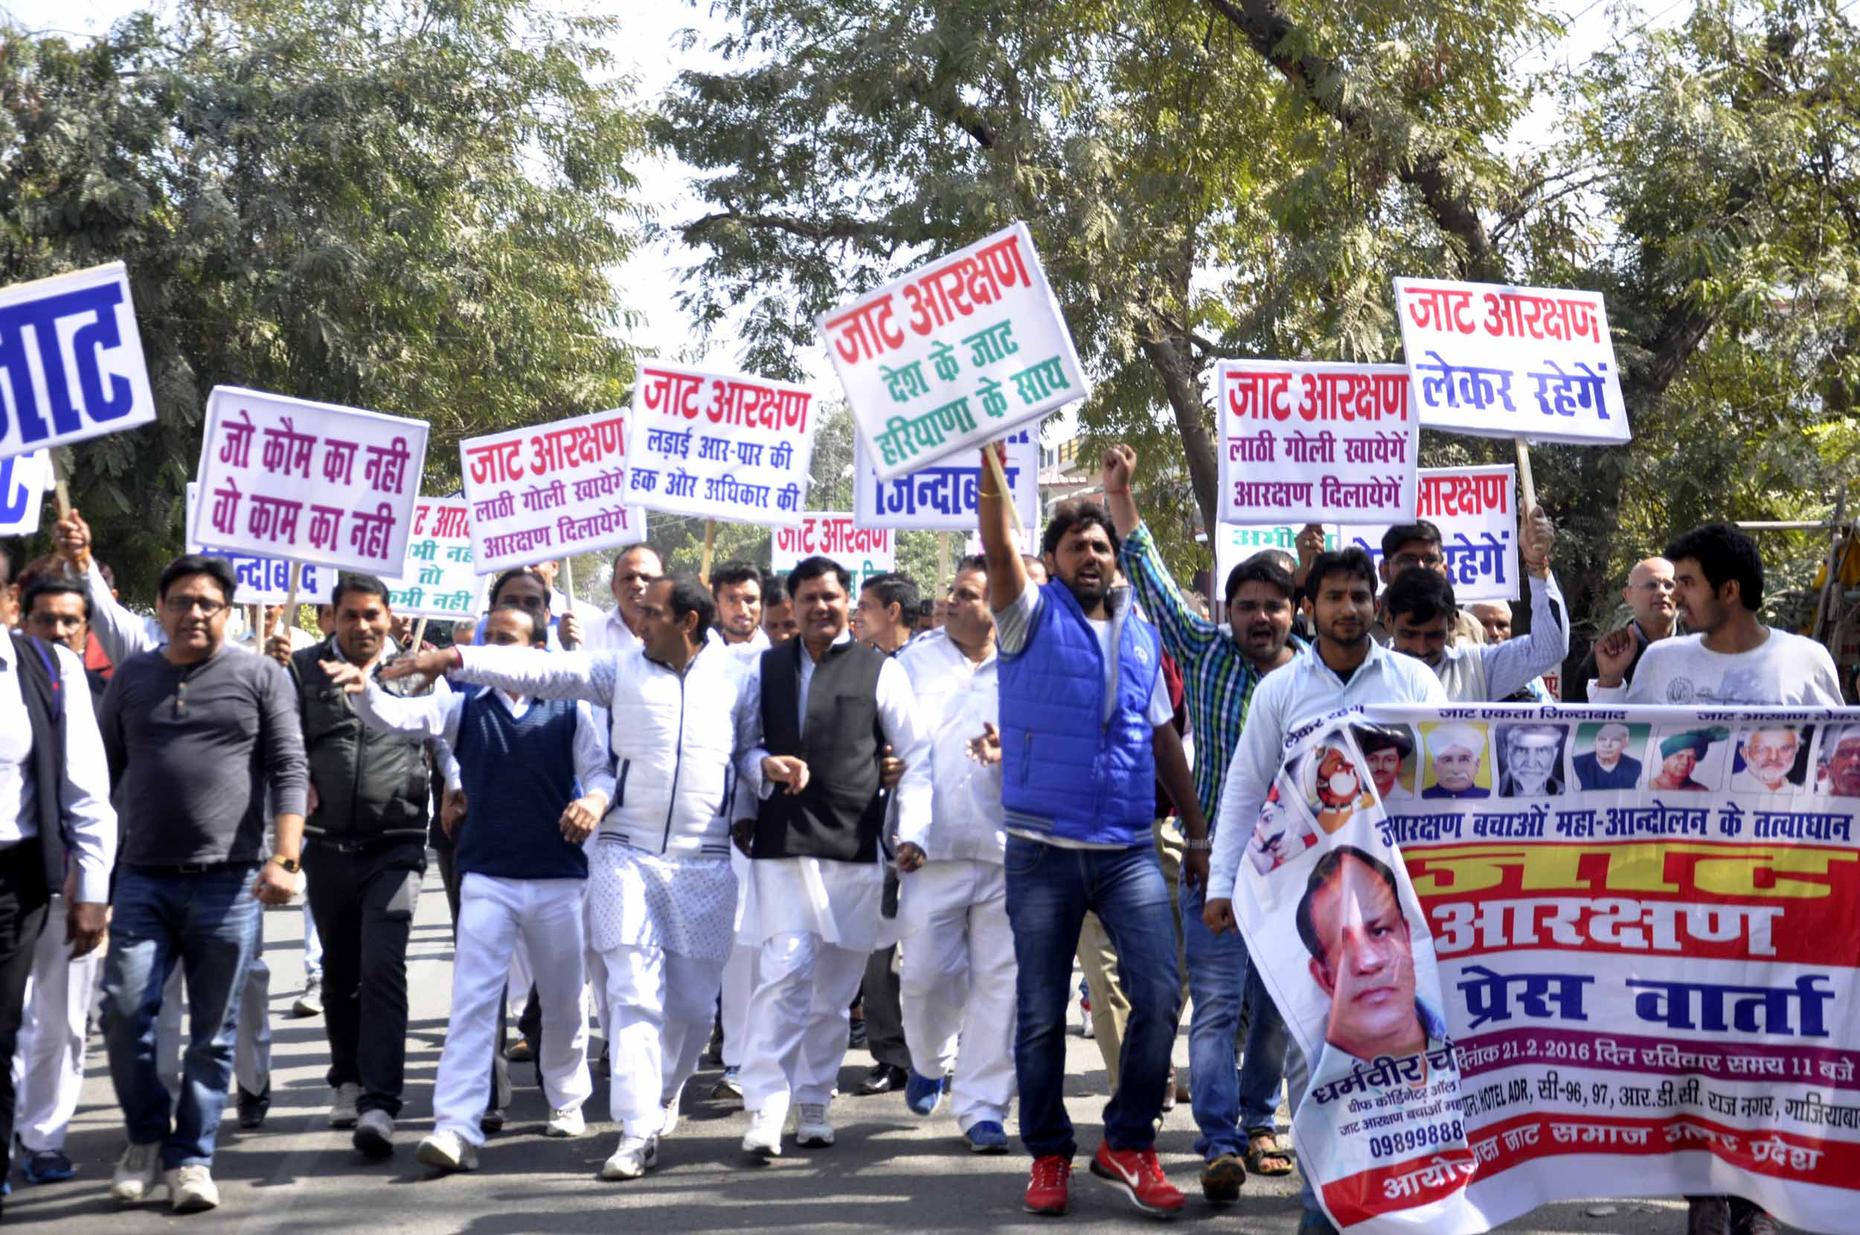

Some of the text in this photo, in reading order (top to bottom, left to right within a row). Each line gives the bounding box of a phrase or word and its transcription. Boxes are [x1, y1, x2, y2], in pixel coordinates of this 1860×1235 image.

[825, 235, 1032, 365] जाट आरक्षण
[1404, 287, 1600, 344] जाट आरक्षण
[879, 319, 1019, 403] देश के जाट
[1416, 351, 1611, 420] लेकर रहेगें
[644, 369, 812, 434] जाट आरक्षण
[873, 396, 977, 466] हरियाणा
[976, 376, 1008, 418] के
[1226, 372, 1410, 422] जाट आरक्षण
[219, 410, 410, 494] जो कौम का नही
[466, 417, 625, 484] जाट आरक्षण
[647, 427, 793, 470] लड़ाई आर-पार की
[1227, 430, 1409, 464] लाठी गोली खायेगें
[474, 490, 515, 522] लाठी
[521, 479, 566, 511] गोली
[630, 467, 659, 492] हक
[665, 467, 698, 498] और
[777, 482, 800, 512] की
[1234, 475, 1404, 508] आरक्षण दिलायेगें
[1416, 474, 1508, 517] आरक्षण
[213, 477, 242, 535] वो
[249, 494, 303, 545] काम
[309, 504, 344, 551] का
[351, 503, 396, 560] नही
[483, 526, 551, 559] आरक्षण
[777, 518, 887, 553] जाट आरक्षण
[419, 564, 445, 585] तो
[1719, 802, 1745, 837] के
[1402, 841, 1858, 899] जाट
[1432, 897, 1784, 956] आरक्षण
[1457, 965, 1835, 1039] प्रेस वार्ता
[1311, 1055, 1421, 1104] धर्मवीर
[1502, 1039, 1590, 1060] 21.2.2016
[1594, 1038, 1636, 1066] दिन
[1641, 1043, 1721, 1072] रविवार
[1726, 1054, 1785, 1075] समय
[1792, 1057, 1812, 1076] 11
[1818, 1056, 1855, 1081] बजे
[1478, 1083, 1506, 1112] HOTEL
[1708, 1091, 1737, 1116] राज
[1785, 1091, 1860, 1129] गाजियाबा
[1502, 1123, 1541, 1151] जाट
[1550, 1123, 1653, 1146] समाज
[1749, 1136, 1824, 1171] प्रदेश
